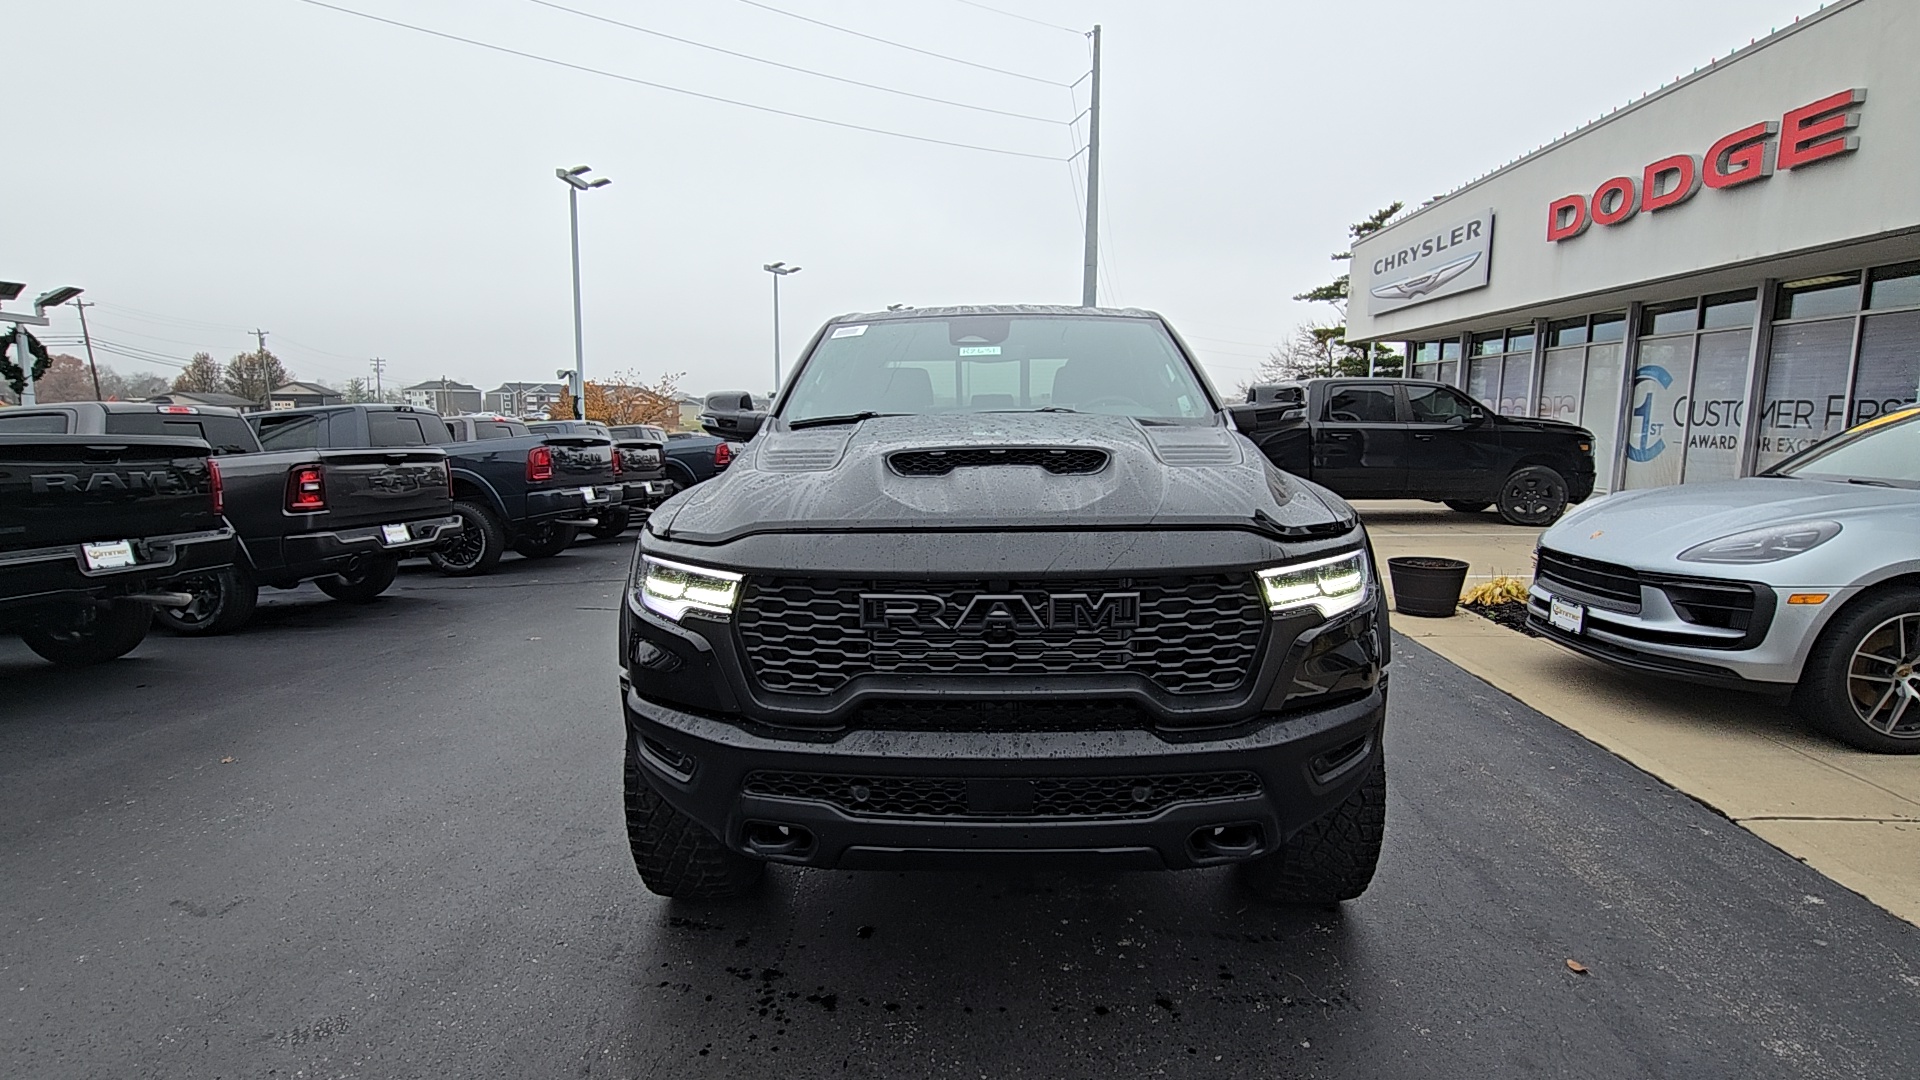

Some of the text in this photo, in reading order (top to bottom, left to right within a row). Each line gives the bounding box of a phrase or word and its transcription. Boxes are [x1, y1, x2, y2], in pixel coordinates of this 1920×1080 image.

[1546, 88, 1866, 242] DODGE
[1373, 219, 1482, 275] CHRYSLER
[1688, 434, 1738, 450] AWARD
[30, 471, 168, 492] RAM
[859, 592, 1140, 630] RAM
